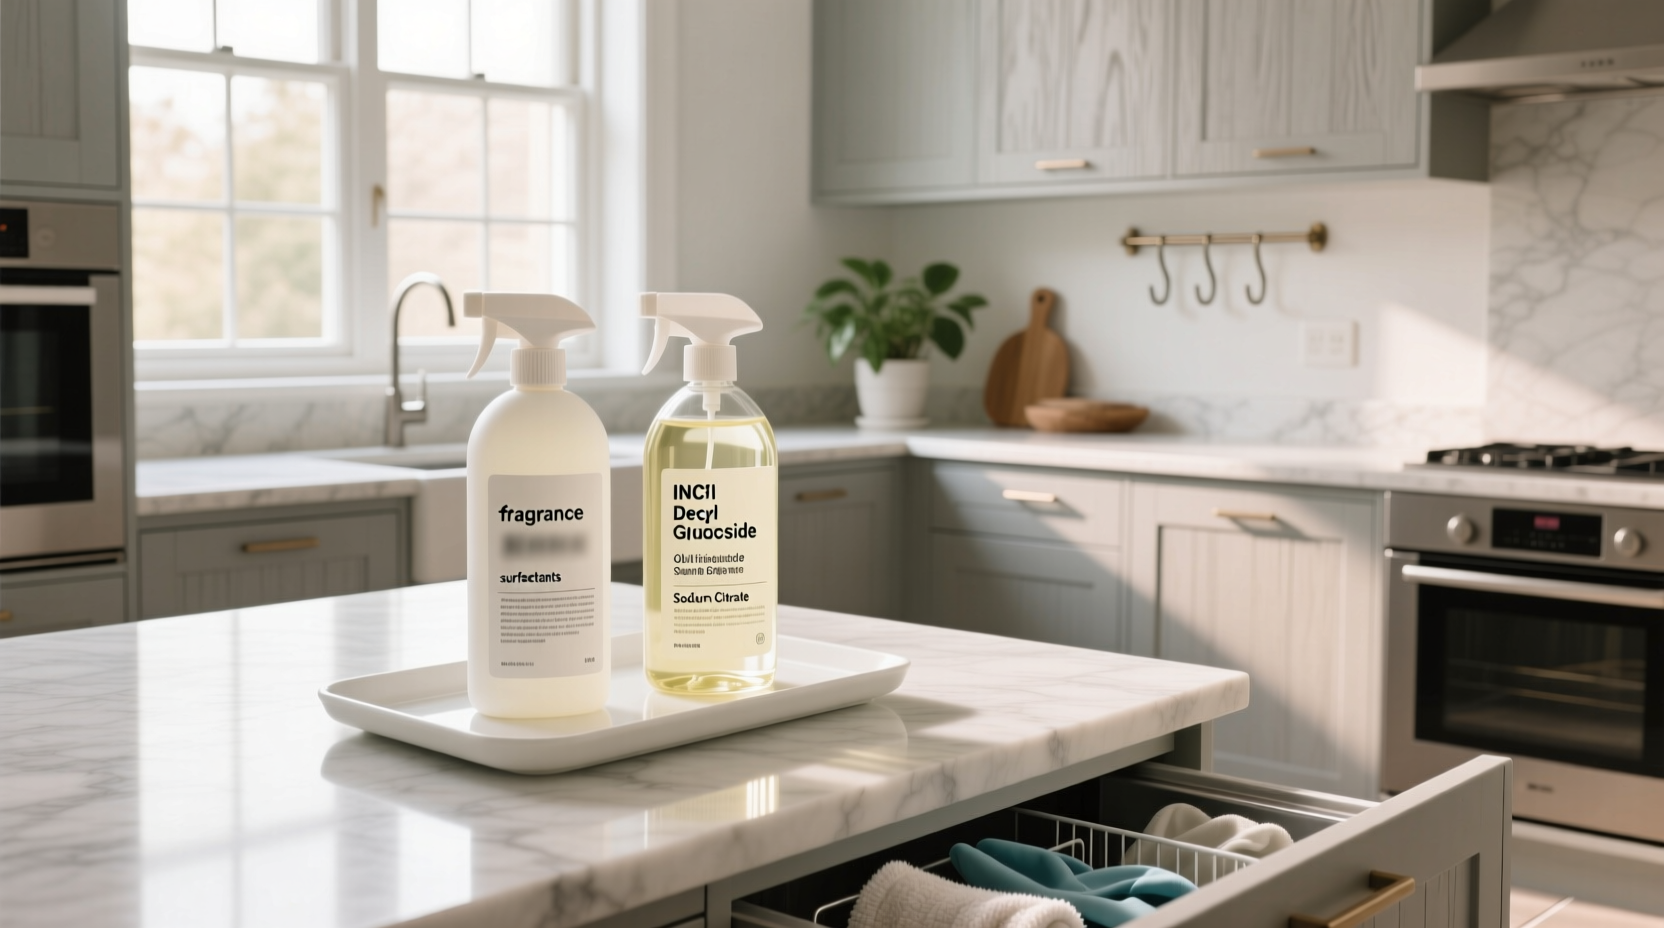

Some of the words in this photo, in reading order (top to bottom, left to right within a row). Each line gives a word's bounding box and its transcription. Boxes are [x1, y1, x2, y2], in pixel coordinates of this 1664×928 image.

[498, 504, 584, 526] fragrance
[673, 504, 718, 524] Decyl
[499, 571, 562, 583] surfactants
[714, 591, 750, 603] Citrate
